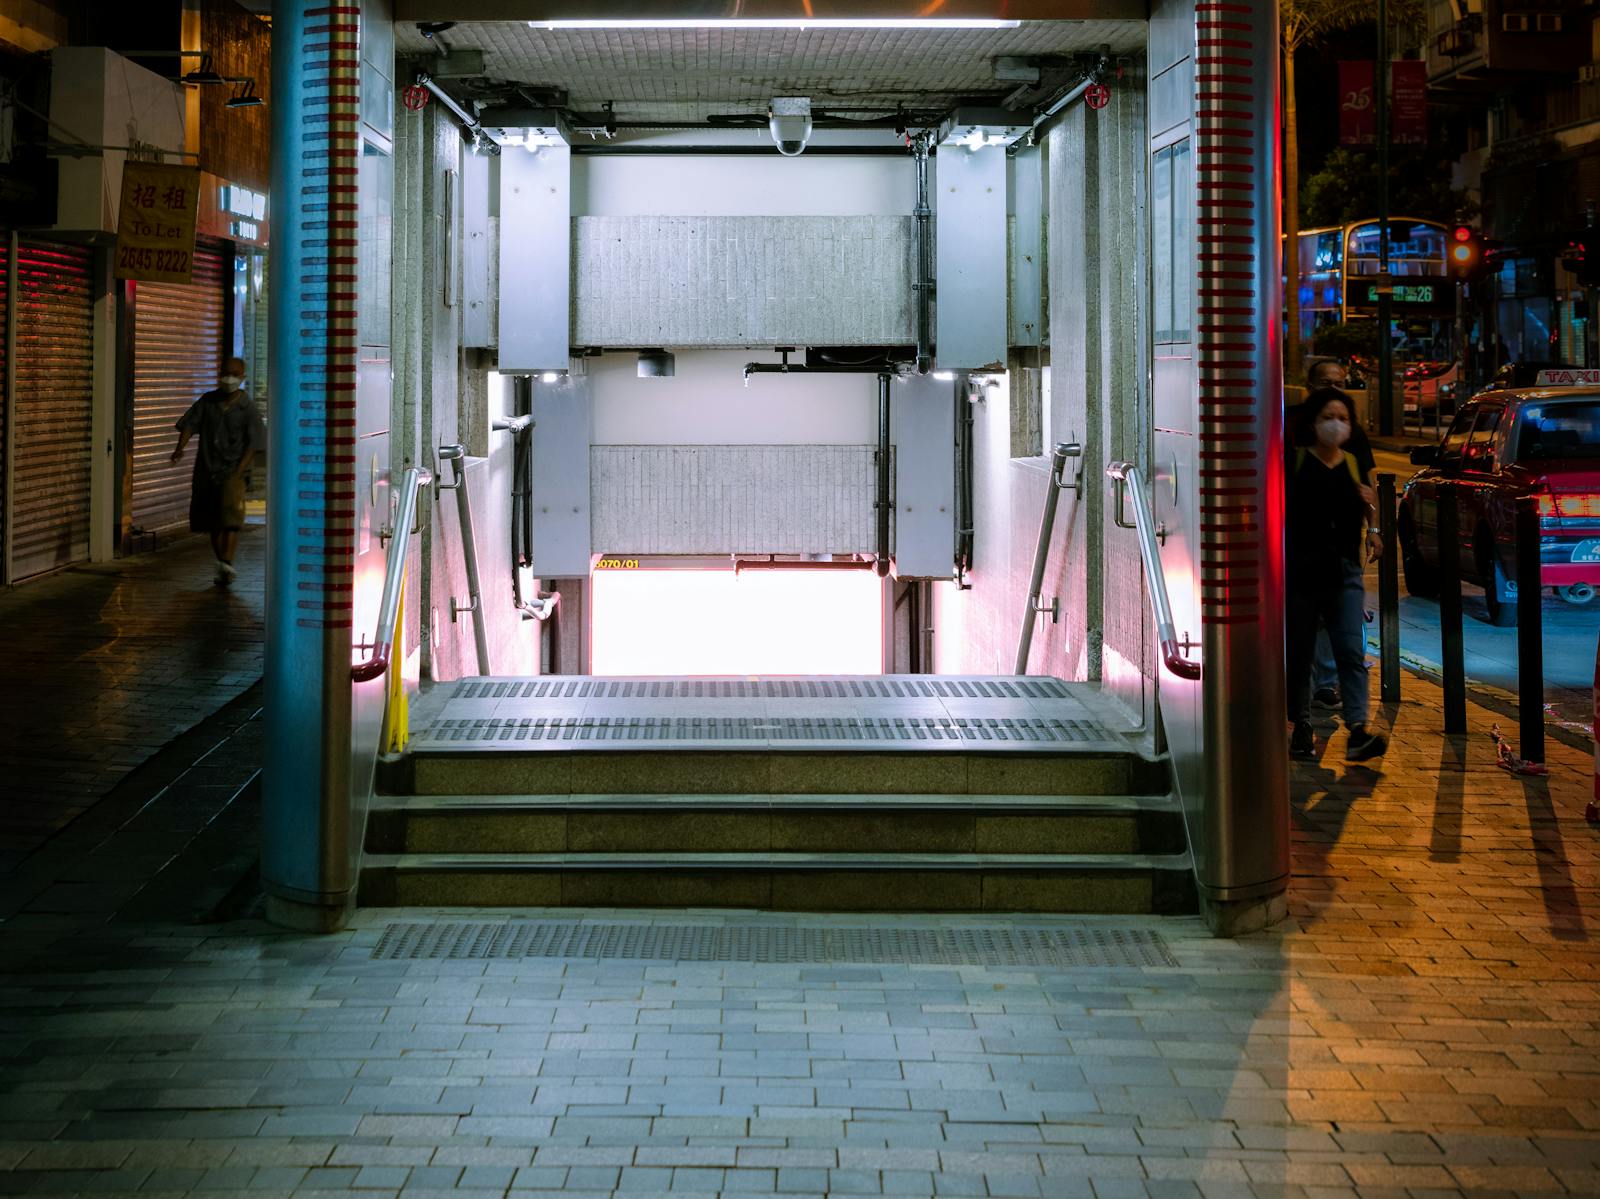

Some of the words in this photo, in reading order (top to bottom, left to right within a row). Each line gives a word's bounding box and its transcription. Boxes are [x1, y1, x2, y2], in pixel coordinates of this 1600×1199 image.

[132, 183, 187, 210] 招租
[132, 221, 151, 237] To
[156, 223, 182, 238] Let
[120, 246, 151, 270] 2645
[156, 250, 187, 273] 8222
[1417, 284, 1434, 302] 26
[1545, 370, 1599, 383] TAXI
